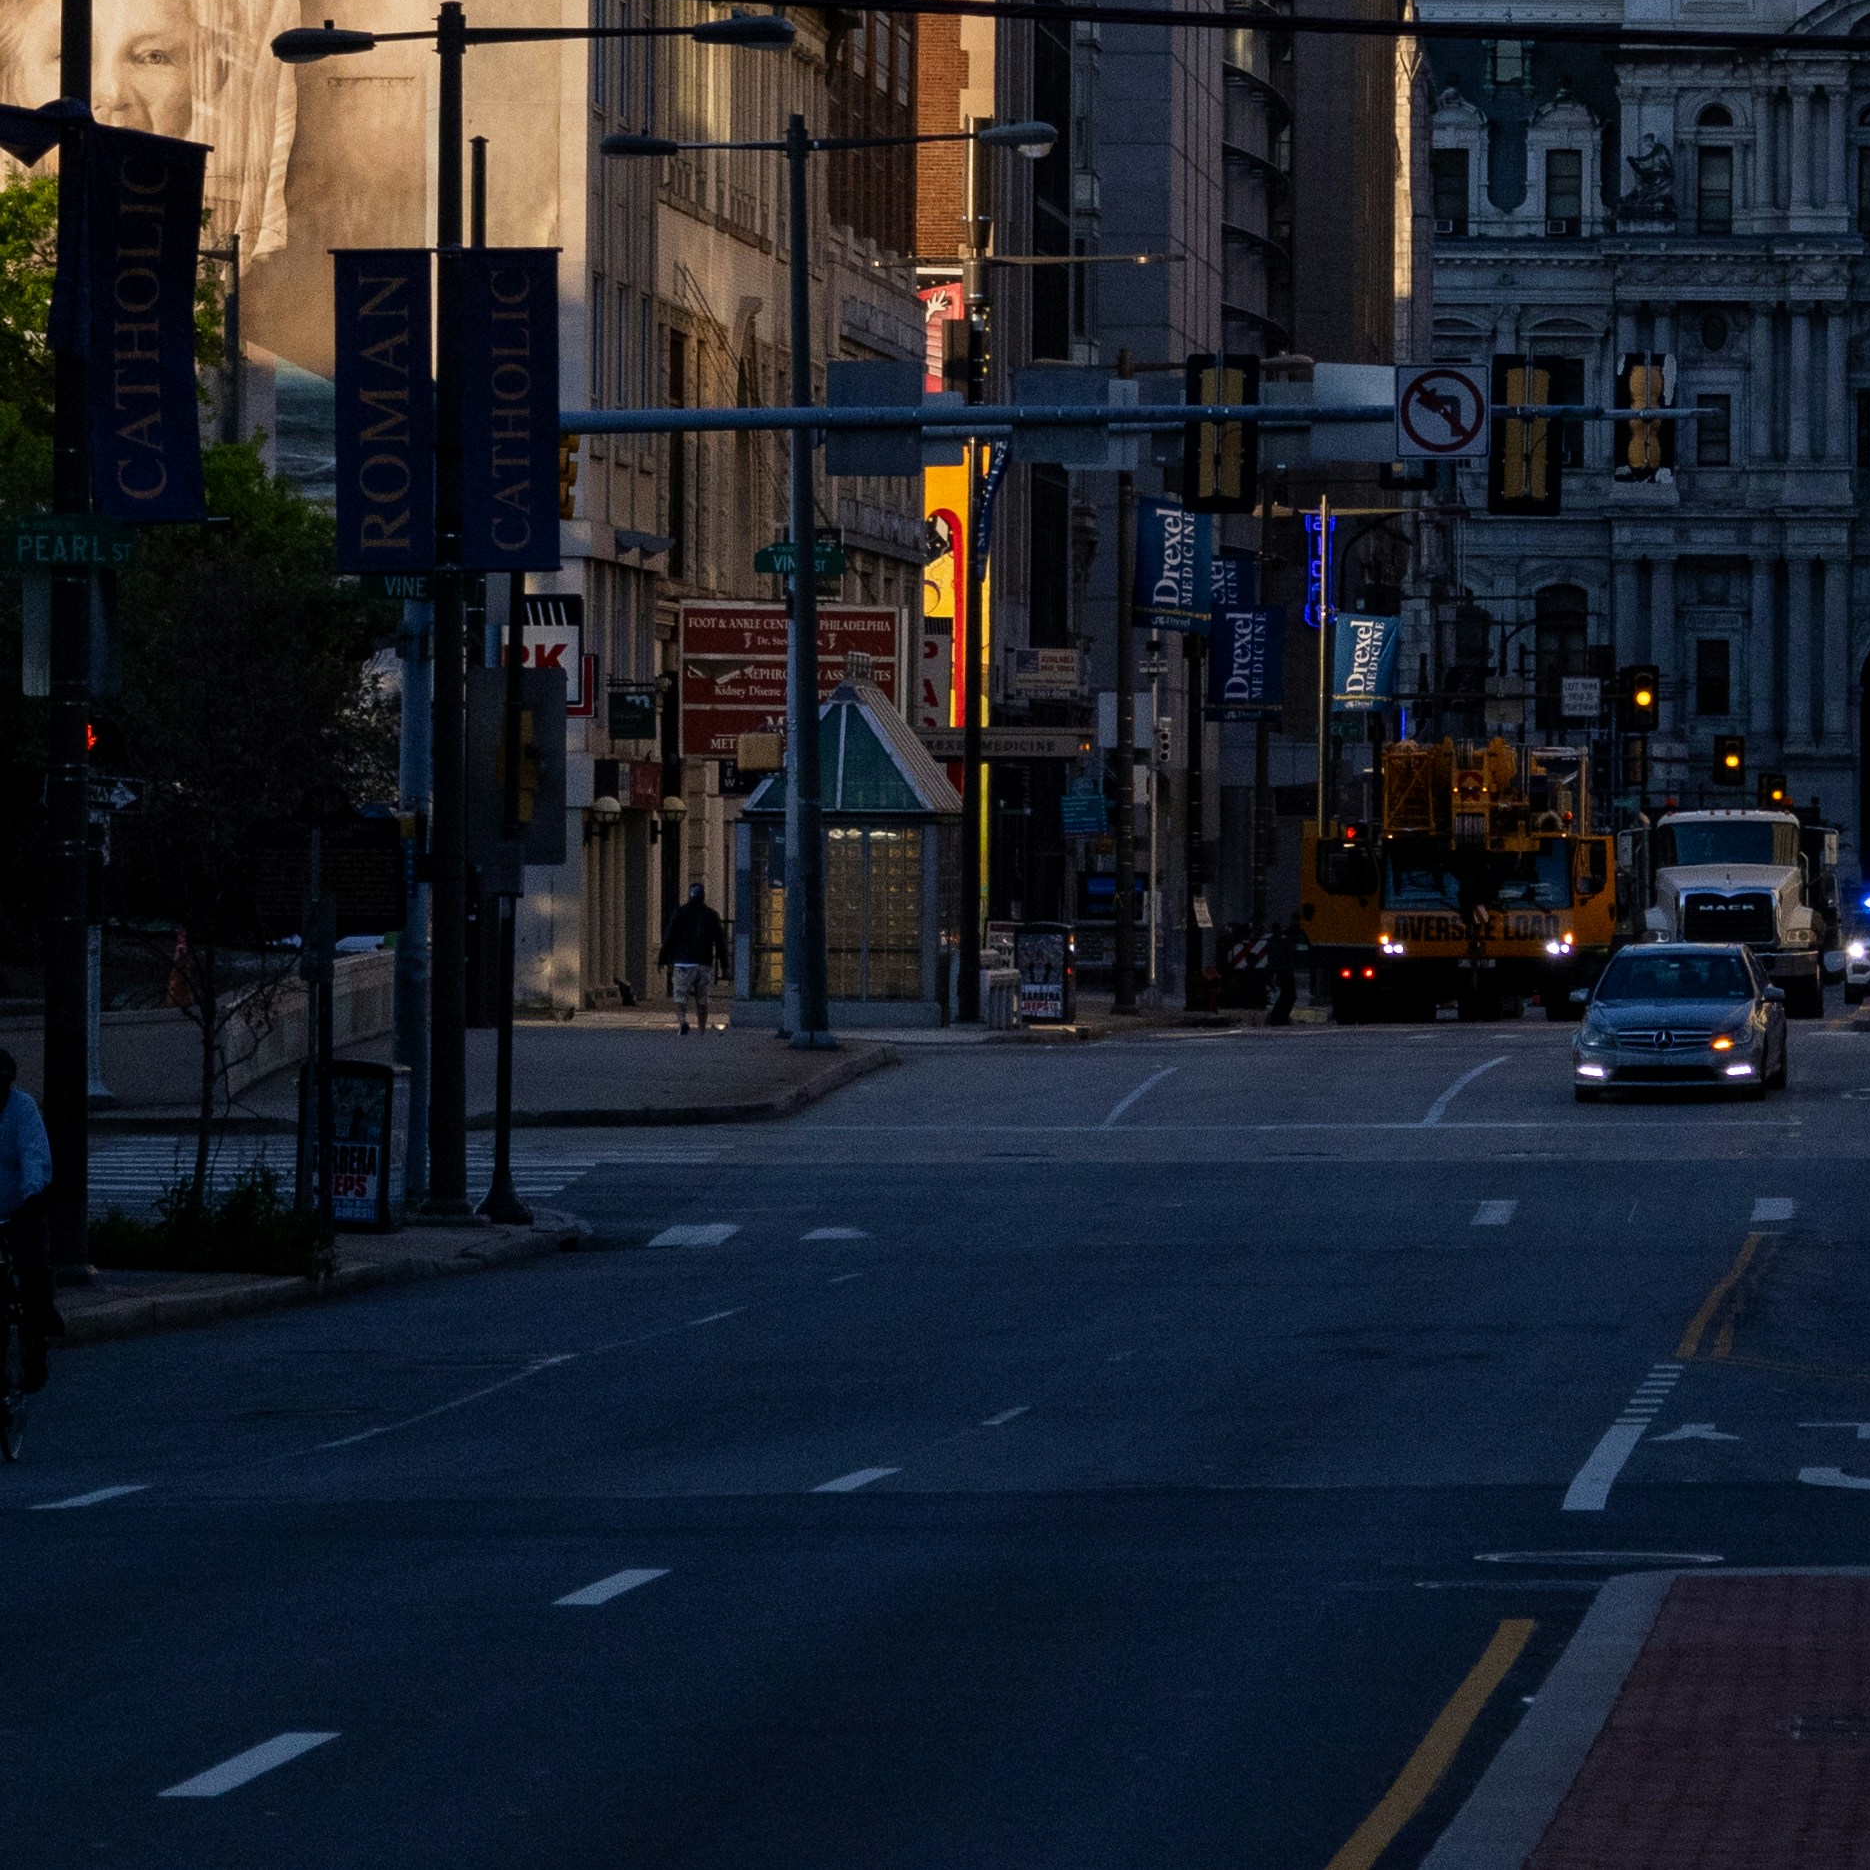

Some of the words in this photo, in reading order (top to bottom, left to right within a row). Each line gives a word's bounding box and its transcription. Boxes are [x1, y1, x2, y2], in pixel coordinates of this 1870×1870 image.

[113, 156, 169, 501] CATHOLIC
[358, 274, 412, 554] ROMAN
[489, 270, 531, 552] CATHOLIC
[17, 534, 107, 562] PEARL
[111, 541, 133, 562] ST
[772, 554, 798, 572] VIN
[814, 559, 827, 572] ST
[1151, 507, 1183, 607] Drexel
[1179, 509, 1196, 607] MEDICINE
[384, 575, 427, 597] VINE
[687, 616, 717, 629] FOOT
[718, 616, 728, 629] &
[728, 617, 761, 630] ANKLE
[819, 619, 892, 632] PHILADELPHIA
[1223, 610, 1255, 703] Drexel
[1251, 611, 1268, 699] MEDICINE
[1345, 619, 1374, 694] Drexel
[1365, 620, 1386, 693] MEDICINE
[714, 685, 746, 699] Kidney
[1503, 914, 1560, 941] LOAD
[1698, 904, 1756, 912] MACK
